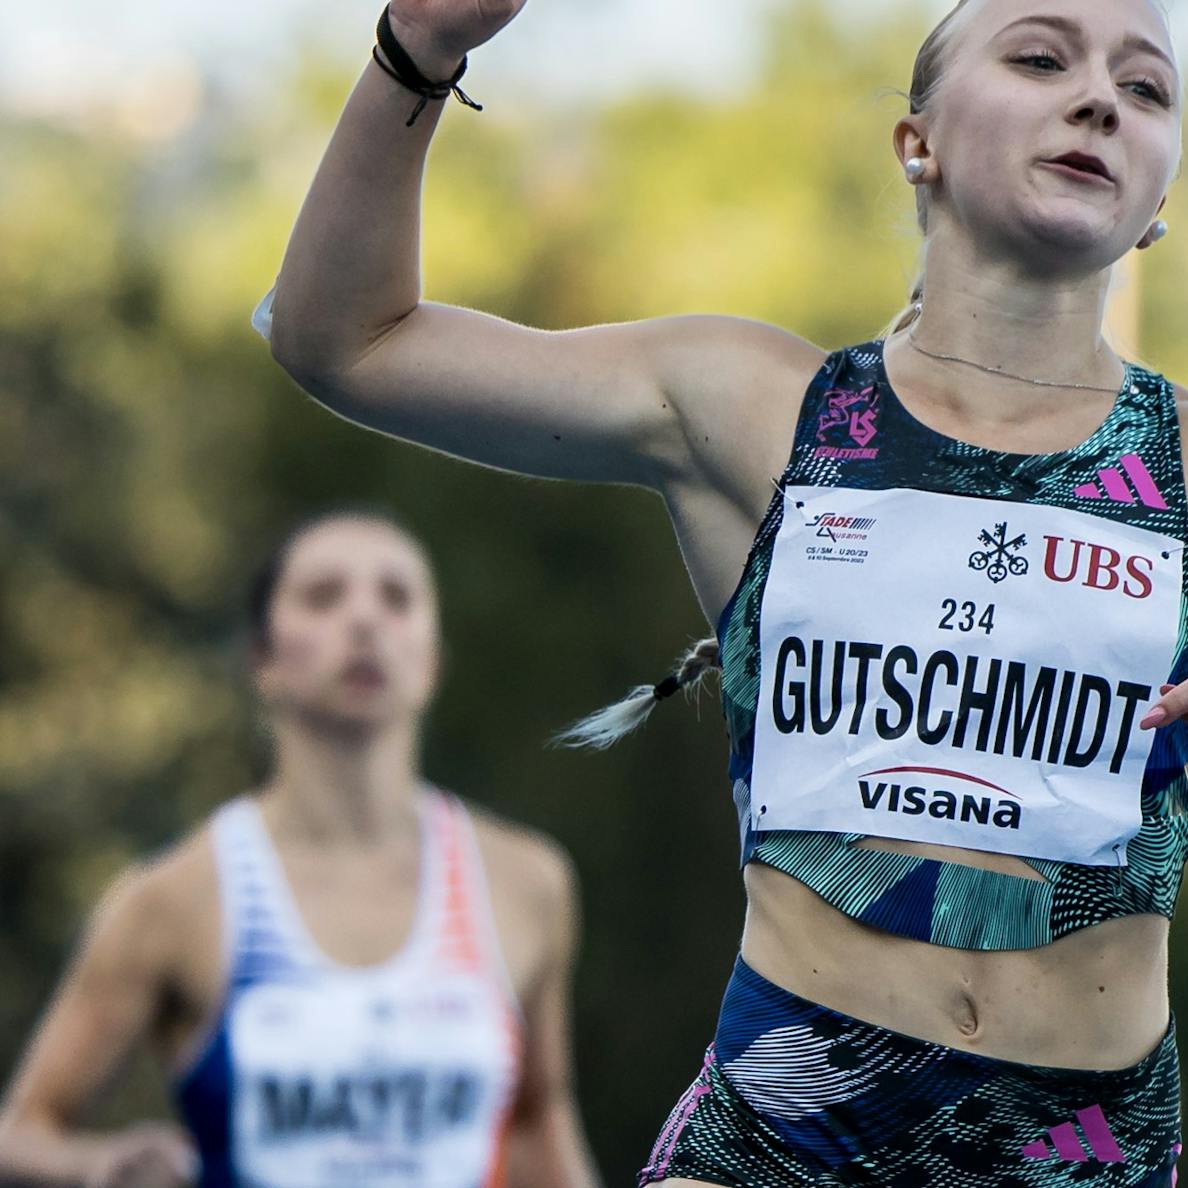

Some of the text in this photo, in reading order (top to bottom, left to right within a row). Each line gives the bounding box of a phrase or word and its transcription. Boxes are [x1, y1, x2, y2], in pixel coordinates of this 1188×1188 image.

[1042, 535, 1154, 600] UBS
[938, 598, 996, 635] 234
[772, 636, 1152, 774] GUTSCHMIDT
